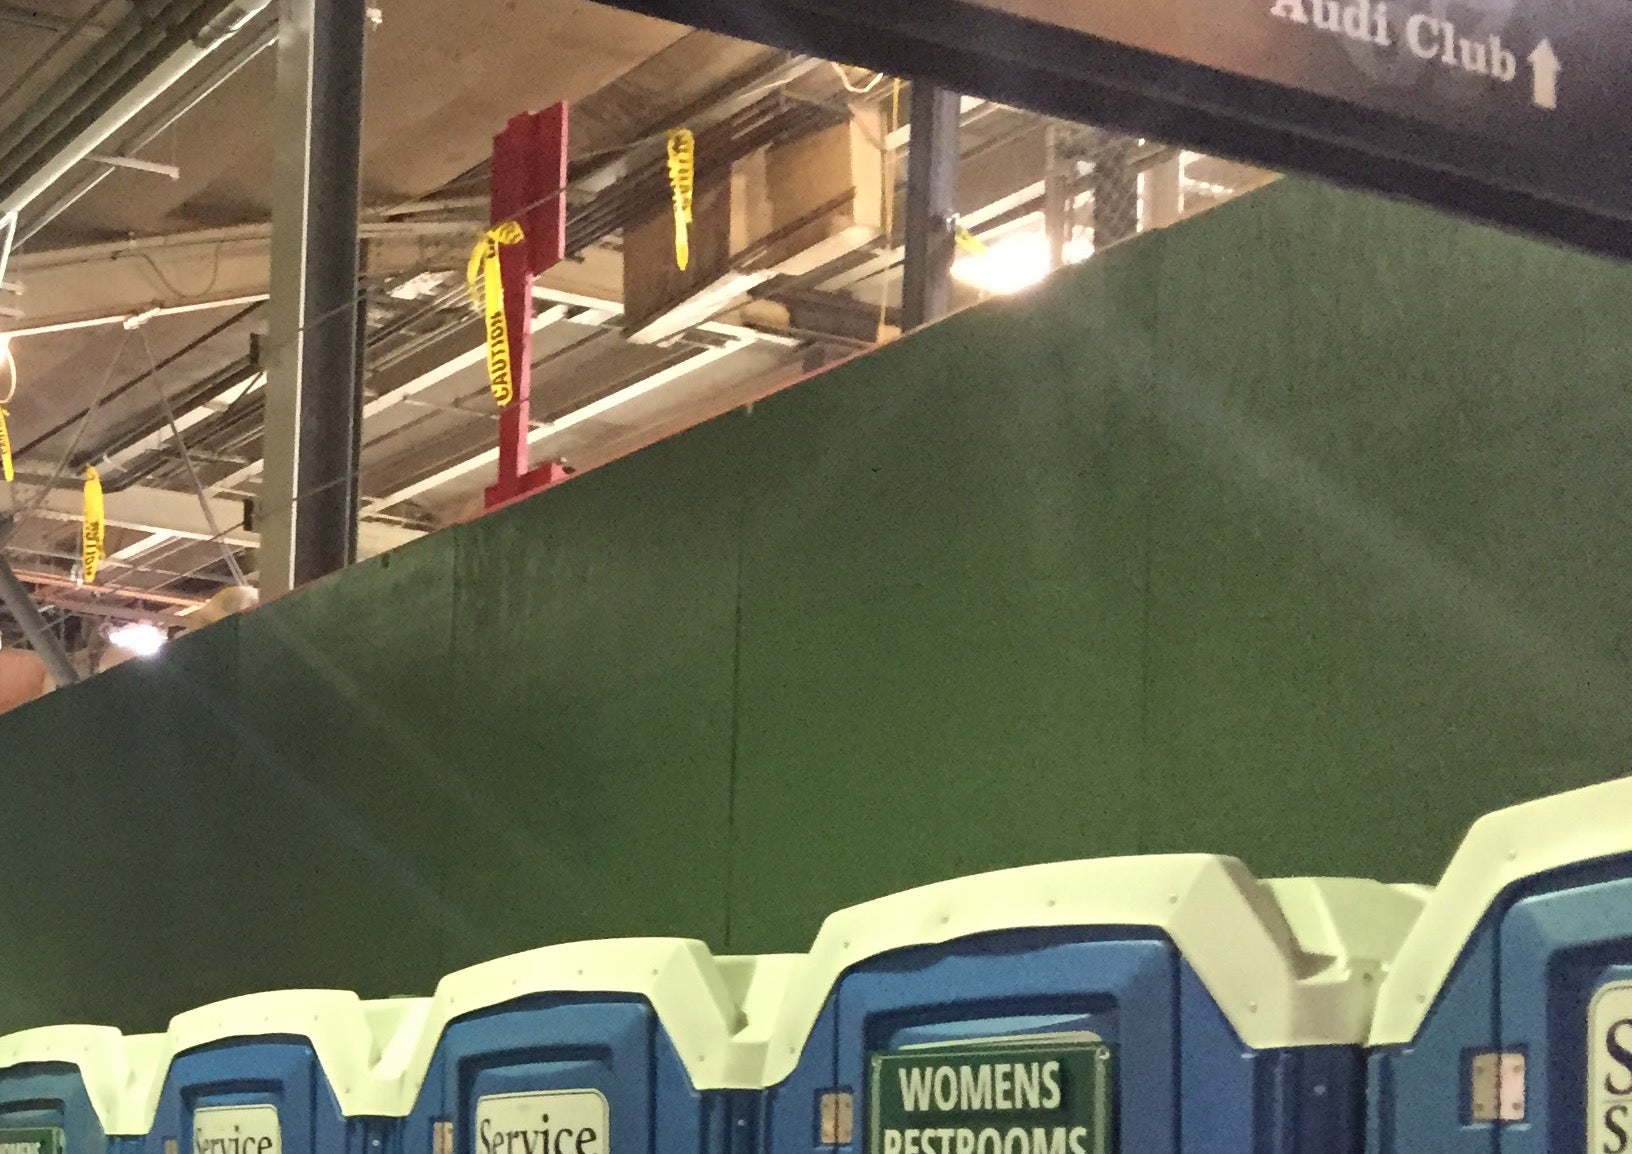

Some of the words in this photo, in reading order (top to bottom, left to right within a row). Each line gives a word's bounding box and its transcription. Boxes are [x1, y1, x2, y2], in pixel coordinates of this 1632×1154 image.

[1270, 0, 1391, 46] Audi
[1406, 14, 1517, 82] Club
[897, 1060, 1062, 1112] WOMENS
